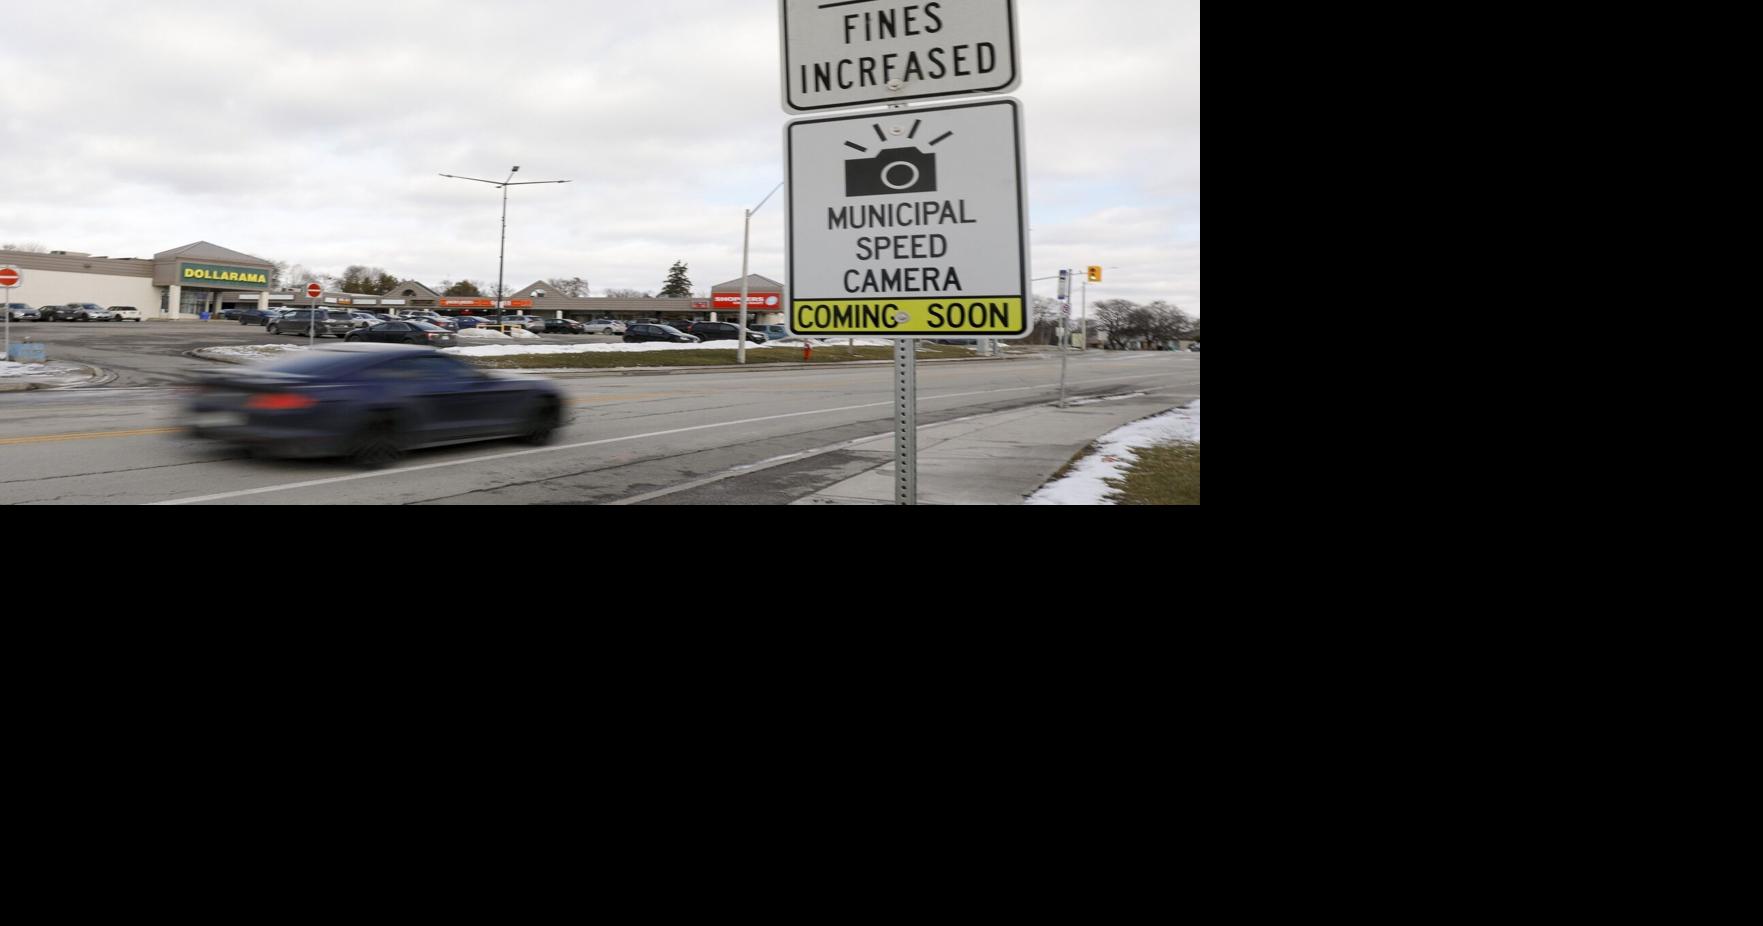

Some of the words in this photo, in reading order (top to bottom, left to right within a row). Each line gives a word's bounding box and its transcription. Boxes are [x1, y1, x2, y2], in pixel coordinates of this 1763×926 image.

[844, 2, 943, 44] FINES
[801, 42, 996, 94] INCREASED
[827, 199, 977, 230] MUNICIPAL
[856, 233, 947, 260] SPEED
[184, 268, 266, 283] DOLLARAMA
[843, 266, 963, 293] CAMERA
[797, 303, 900, 329] COMING
[926, 302, 1009, 329] SOON
